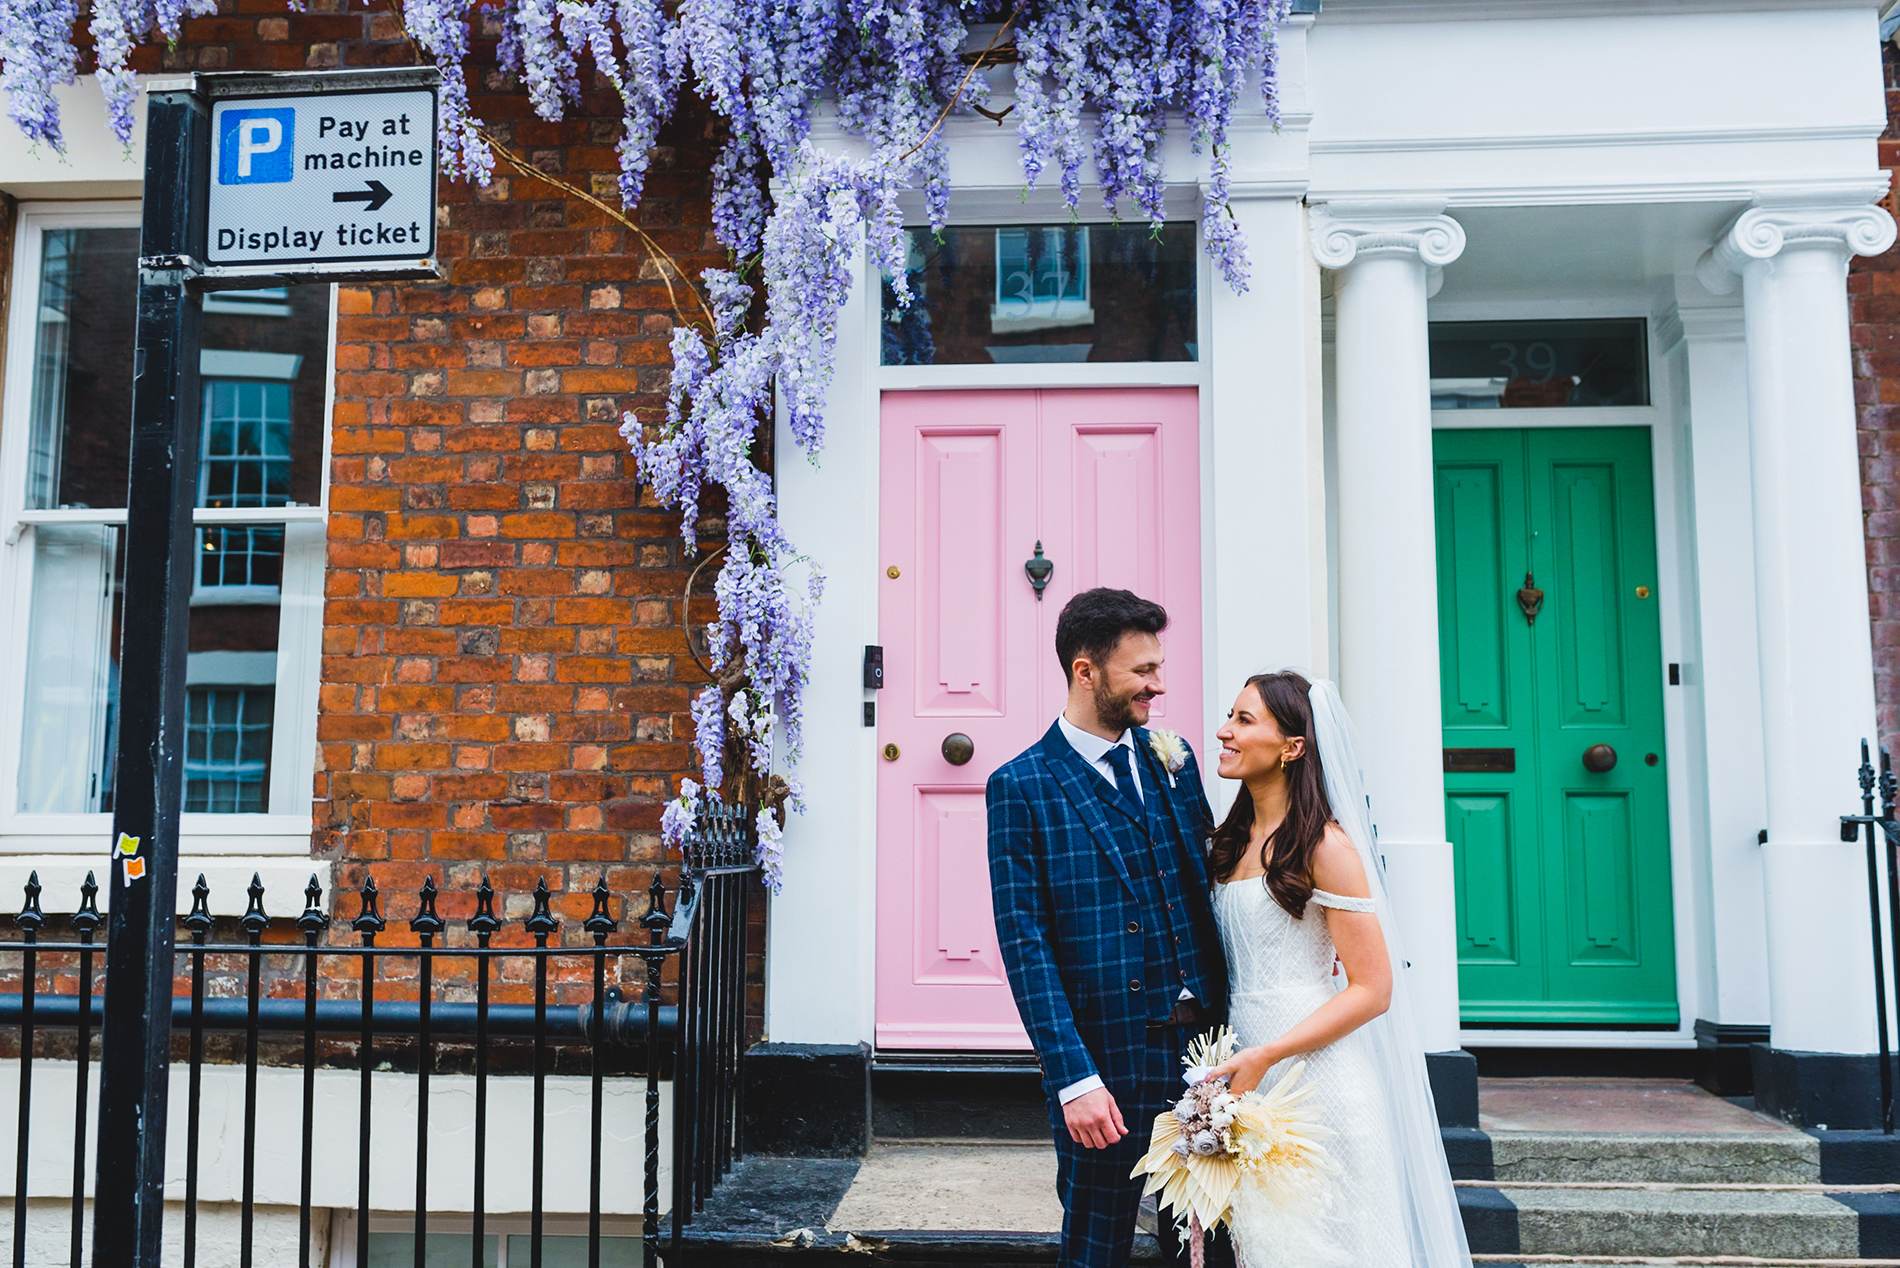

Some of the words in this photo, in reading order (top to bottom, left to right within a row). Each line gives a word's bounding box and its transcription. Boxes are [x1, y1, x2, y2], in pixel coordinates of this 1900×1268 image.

[320, 116, 369, 141] Pay
[383, 114, 410, 135] at
[238, 118, 282, 177] P
[305, 146, 422, 170] machine
[218, 226, 323, 252] Display
[337, 222, 420, 246] ticket
[1006, 271, 1069, 320] 37
[1490, 342, 1556, 386] 39
